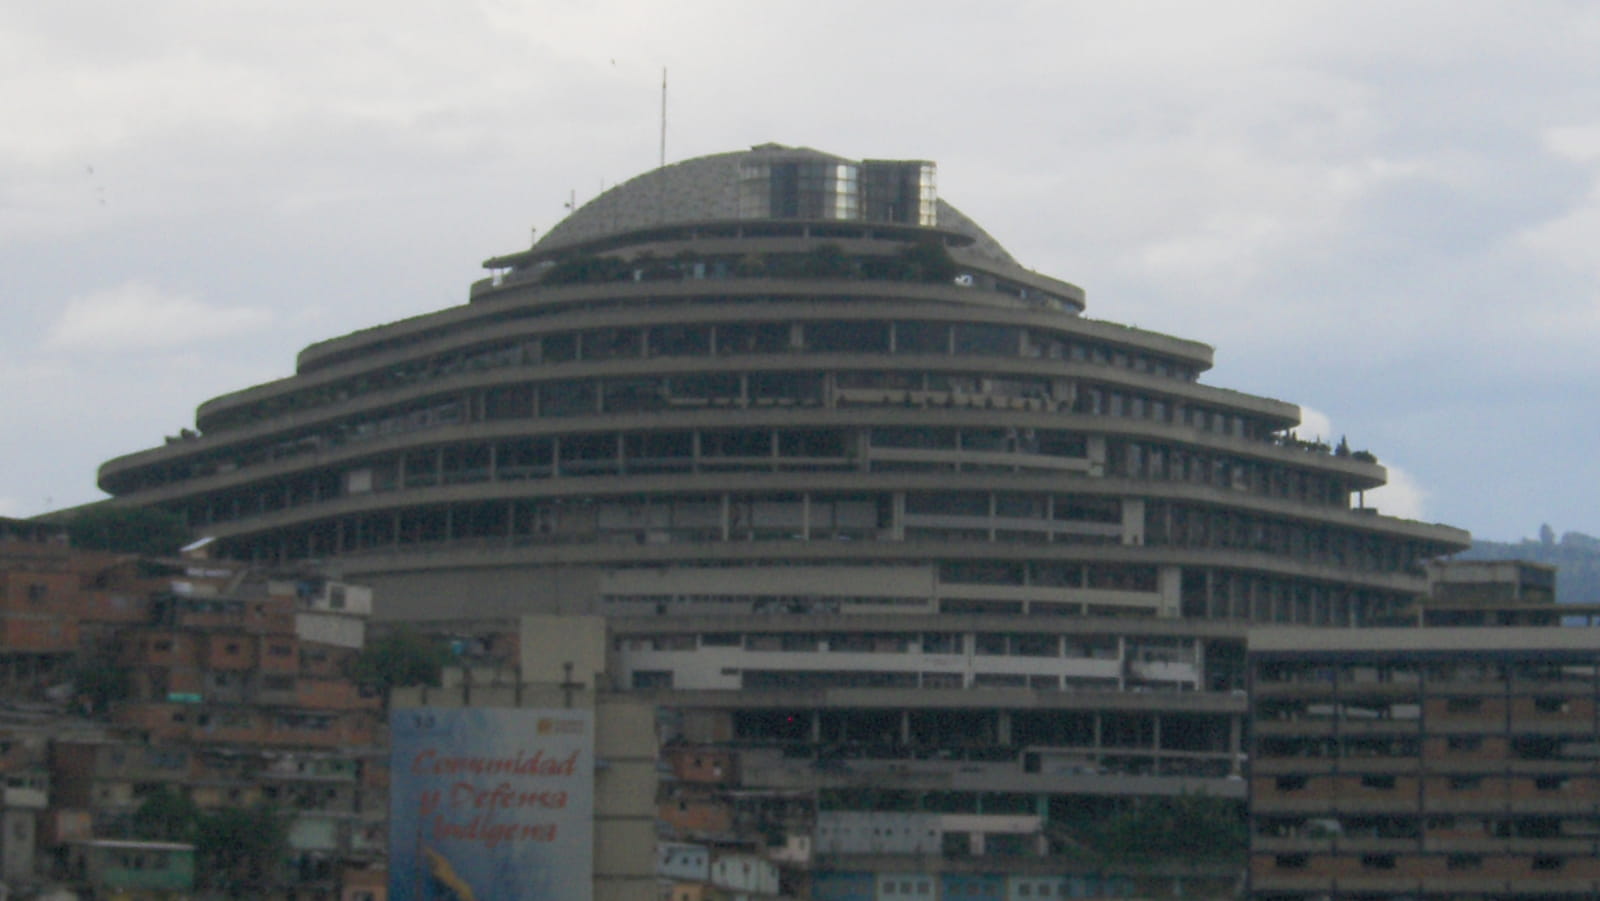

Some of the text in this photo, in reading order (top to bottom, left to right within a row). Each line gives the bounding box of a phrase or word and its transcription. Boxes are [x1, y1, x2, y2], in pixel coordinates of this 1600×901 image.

[412, 750, 581, 776] Comunidad
[419, 782, 568, 816] y Defensa
